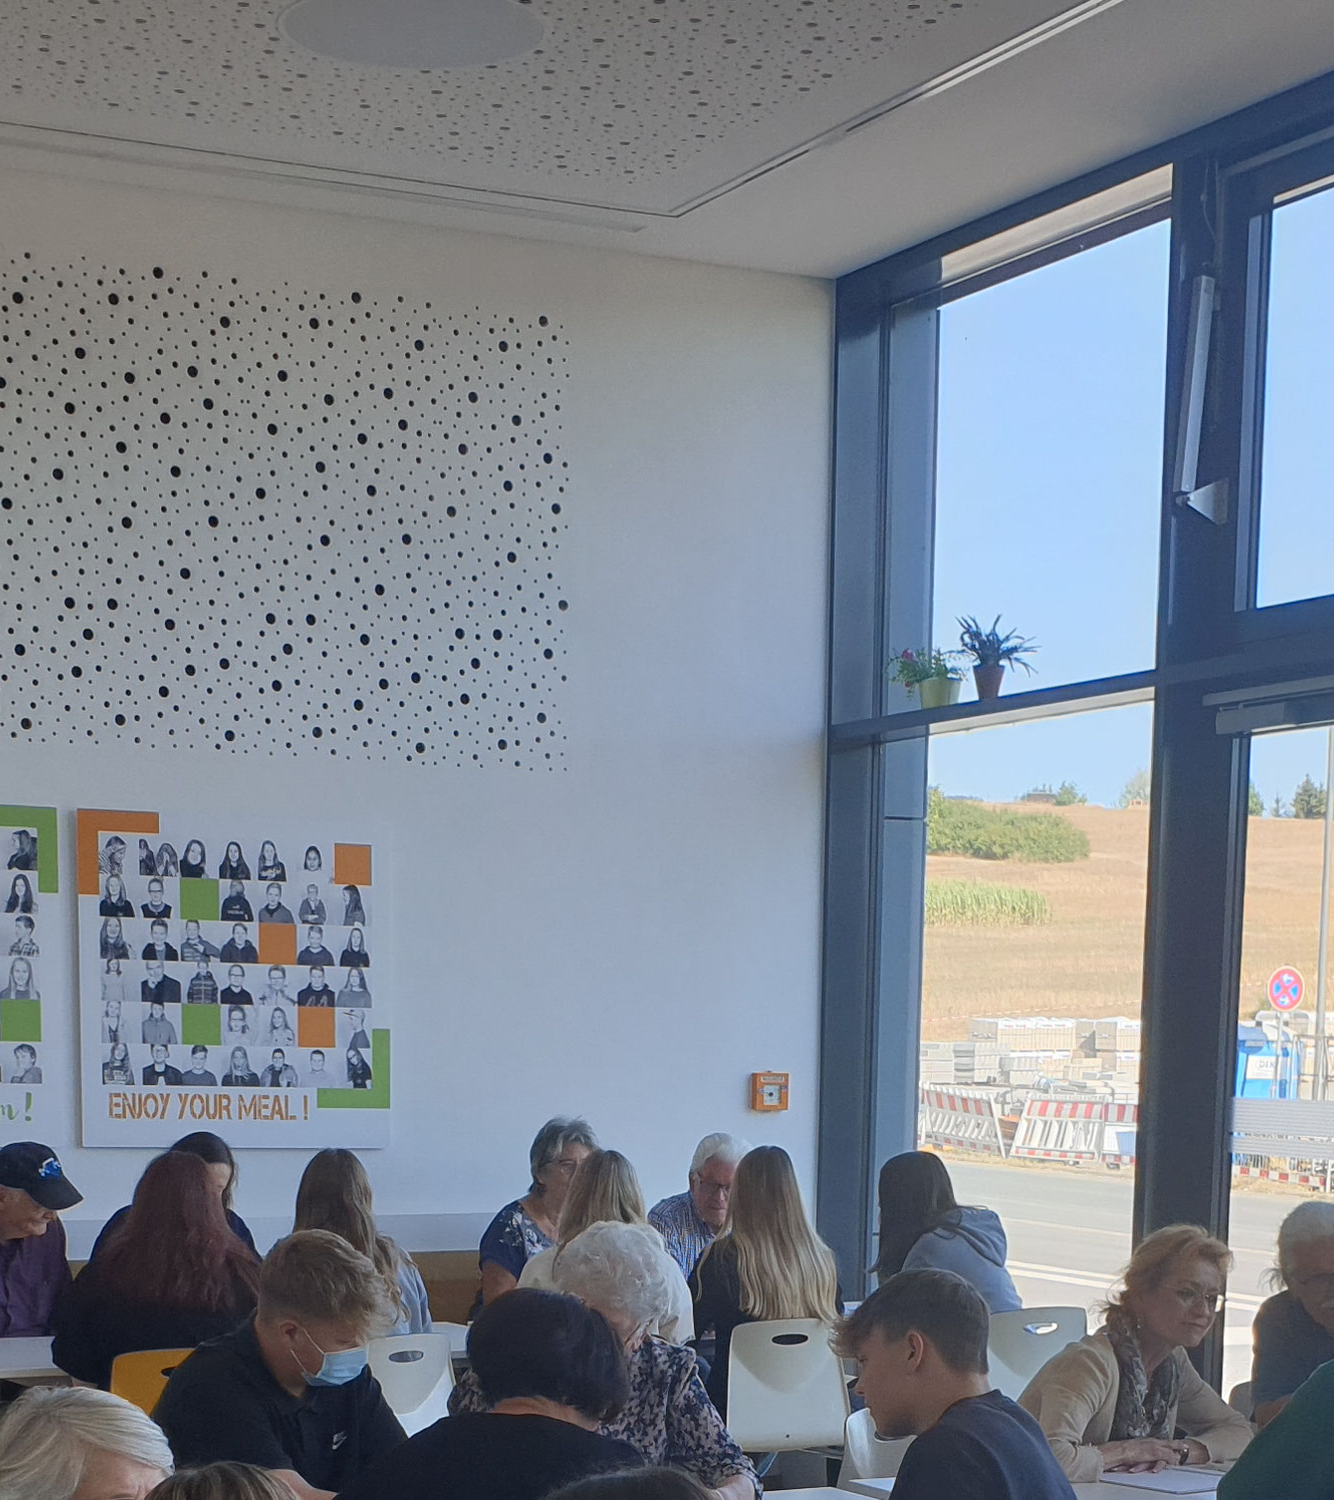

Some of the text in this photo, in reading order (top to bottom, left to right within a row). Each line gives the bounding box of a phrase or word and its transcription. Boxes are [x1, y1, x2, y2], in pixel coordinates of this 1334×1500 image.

[108, 1092, 171, 1120] ENJOY
[177, 1093, 232, 1120] YOUR
[237, 1094, 297, 1121] MEAL
